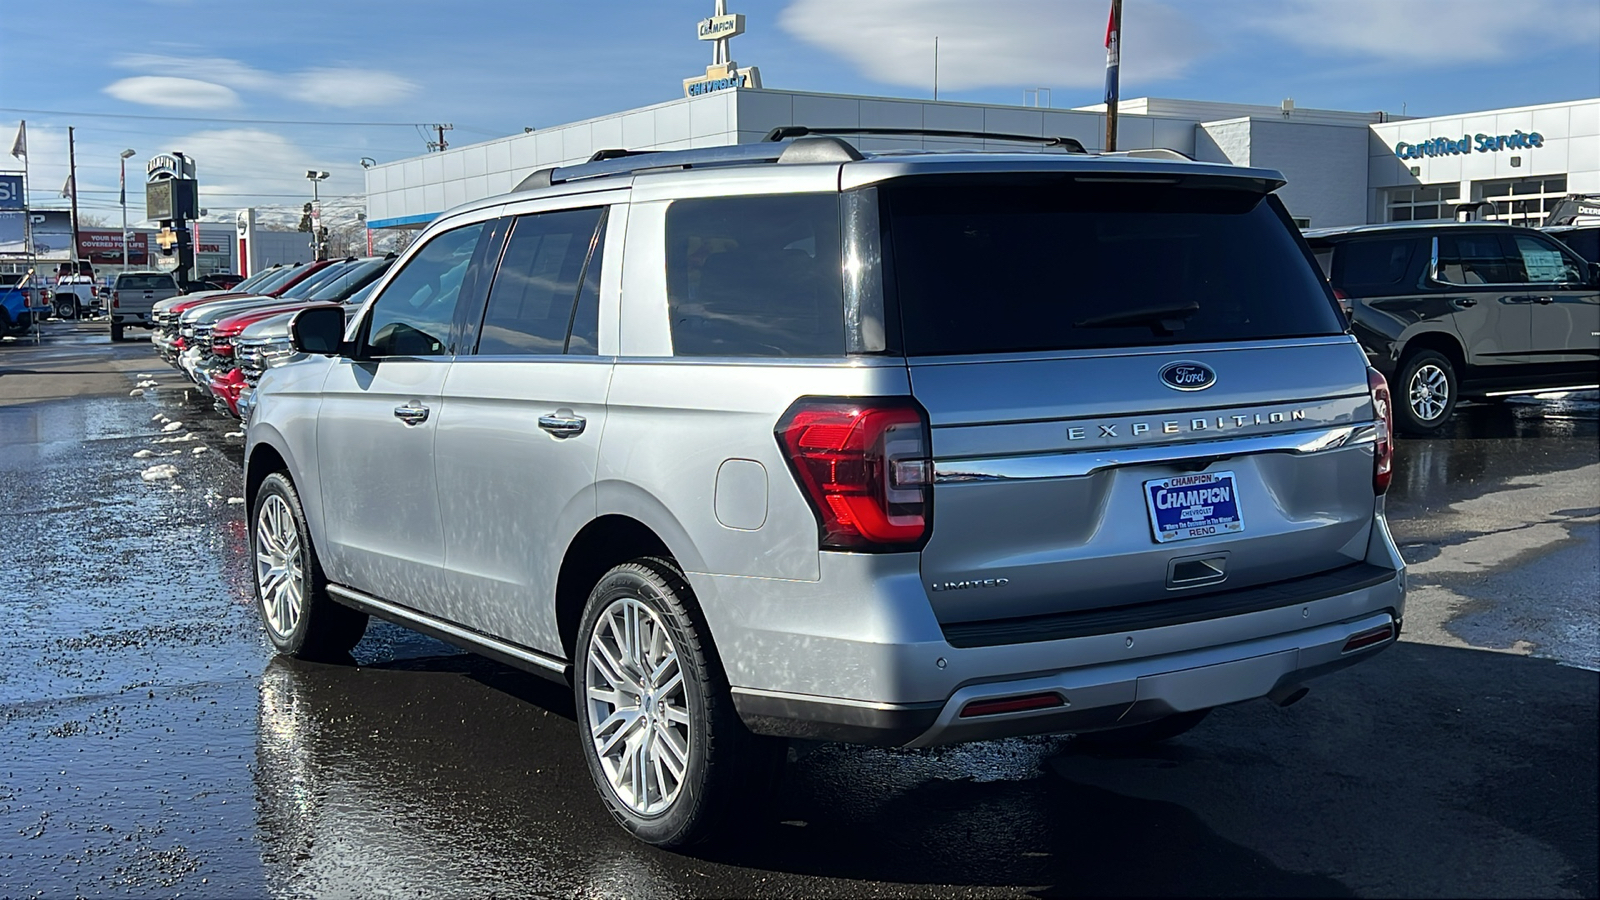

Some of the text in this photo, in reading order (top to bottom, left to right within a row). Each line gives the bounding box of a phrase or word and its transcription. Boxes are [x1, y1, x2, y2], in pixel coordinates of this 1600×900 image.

[688, 75, 745, 96] CHEVROLET
[1395, 129, 1544, 160] Certified Service
[1175, 366, 1206, 384] Ford
[1067, 409, 1306, 441] EXPEDITION
[1171, 474, 1212, 487] CHAMPION
[1157, 487, 1229, 509] CHAMPION
[1182, 508, 1211, 516] CHEVROLET
[1189, 526, 1216, 537] RENO
[932, 578, 1009, 592] LIMITED
